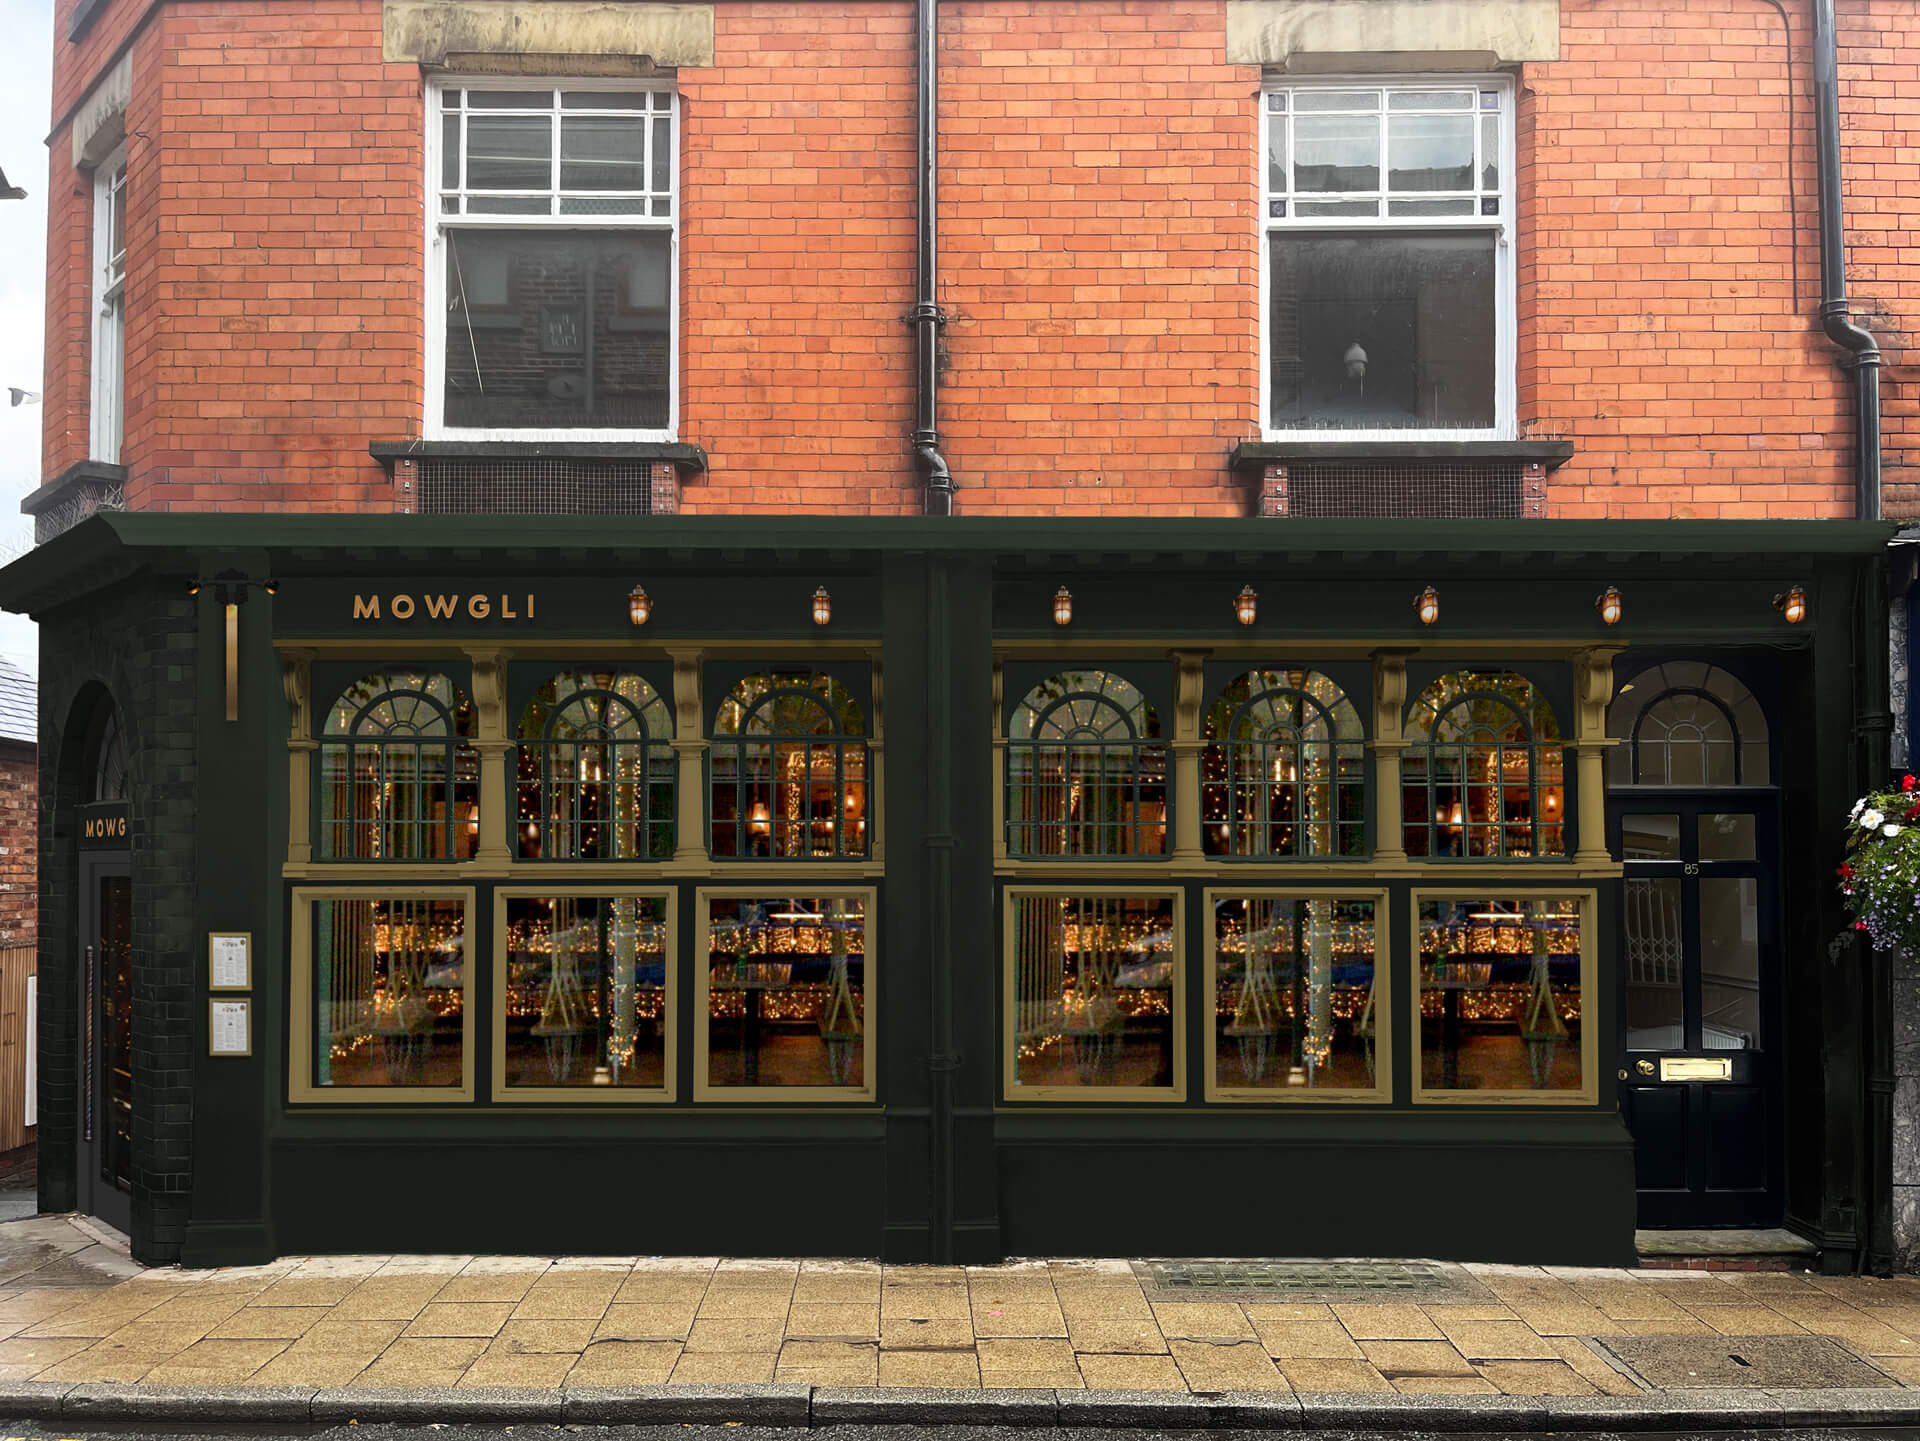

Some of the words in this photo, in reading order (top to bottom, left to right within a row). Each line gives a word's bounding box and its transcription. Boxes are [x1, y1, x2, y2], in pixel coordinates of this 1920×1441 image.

[353, 594, 535, 619] MOWGLI
[85, 817, 126, 838] MOWG
[1685, 863, 1699, 875] 85
